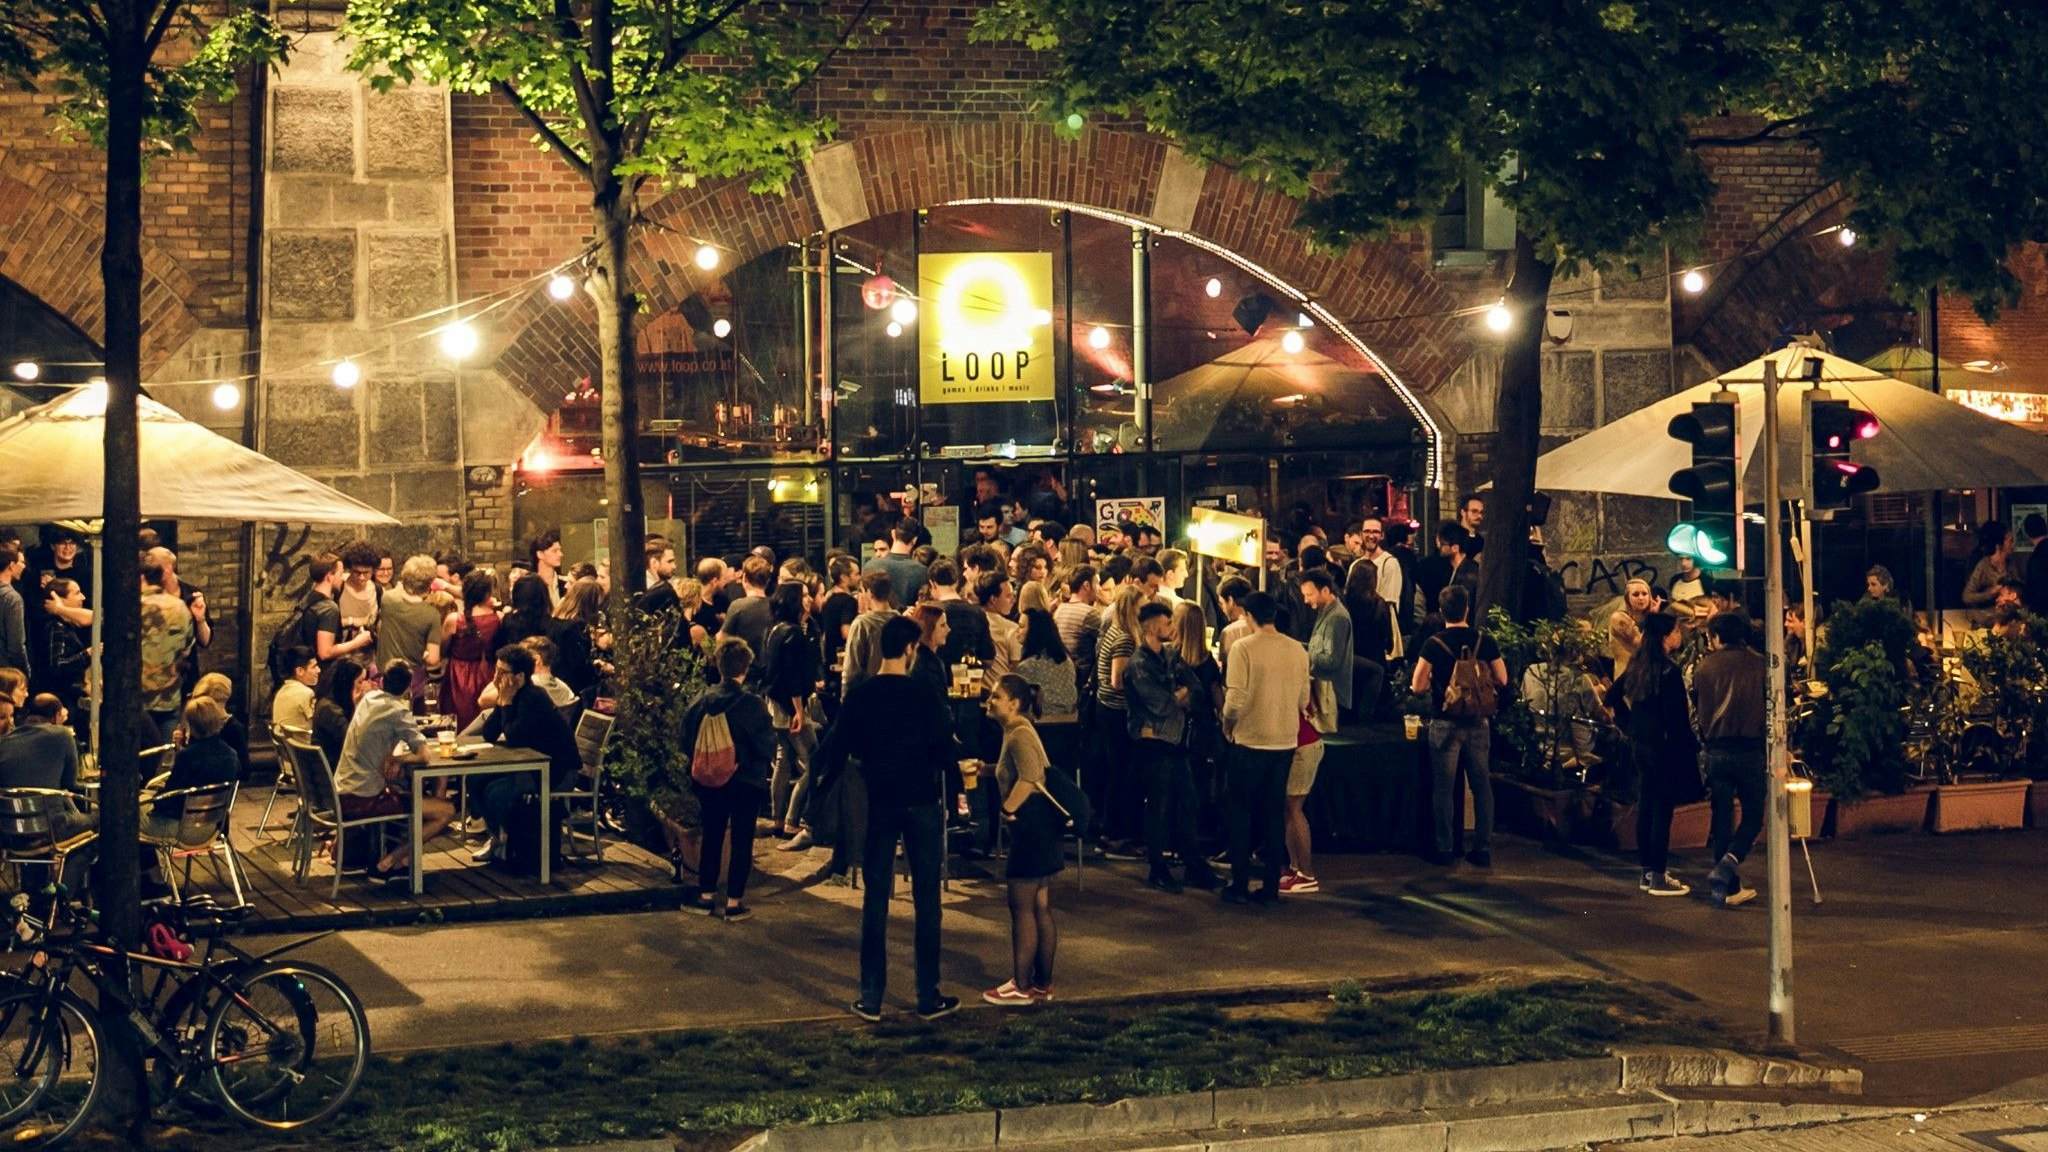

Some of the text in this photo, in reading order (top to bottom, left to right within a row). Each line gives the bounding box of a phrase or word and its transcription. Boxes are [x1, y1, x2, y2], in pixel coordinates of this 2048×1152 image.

[942, 351, 1029, 382] LOOP
[975, 385, 999, 393] drinks
[1008, 384, 1030, 392] music
